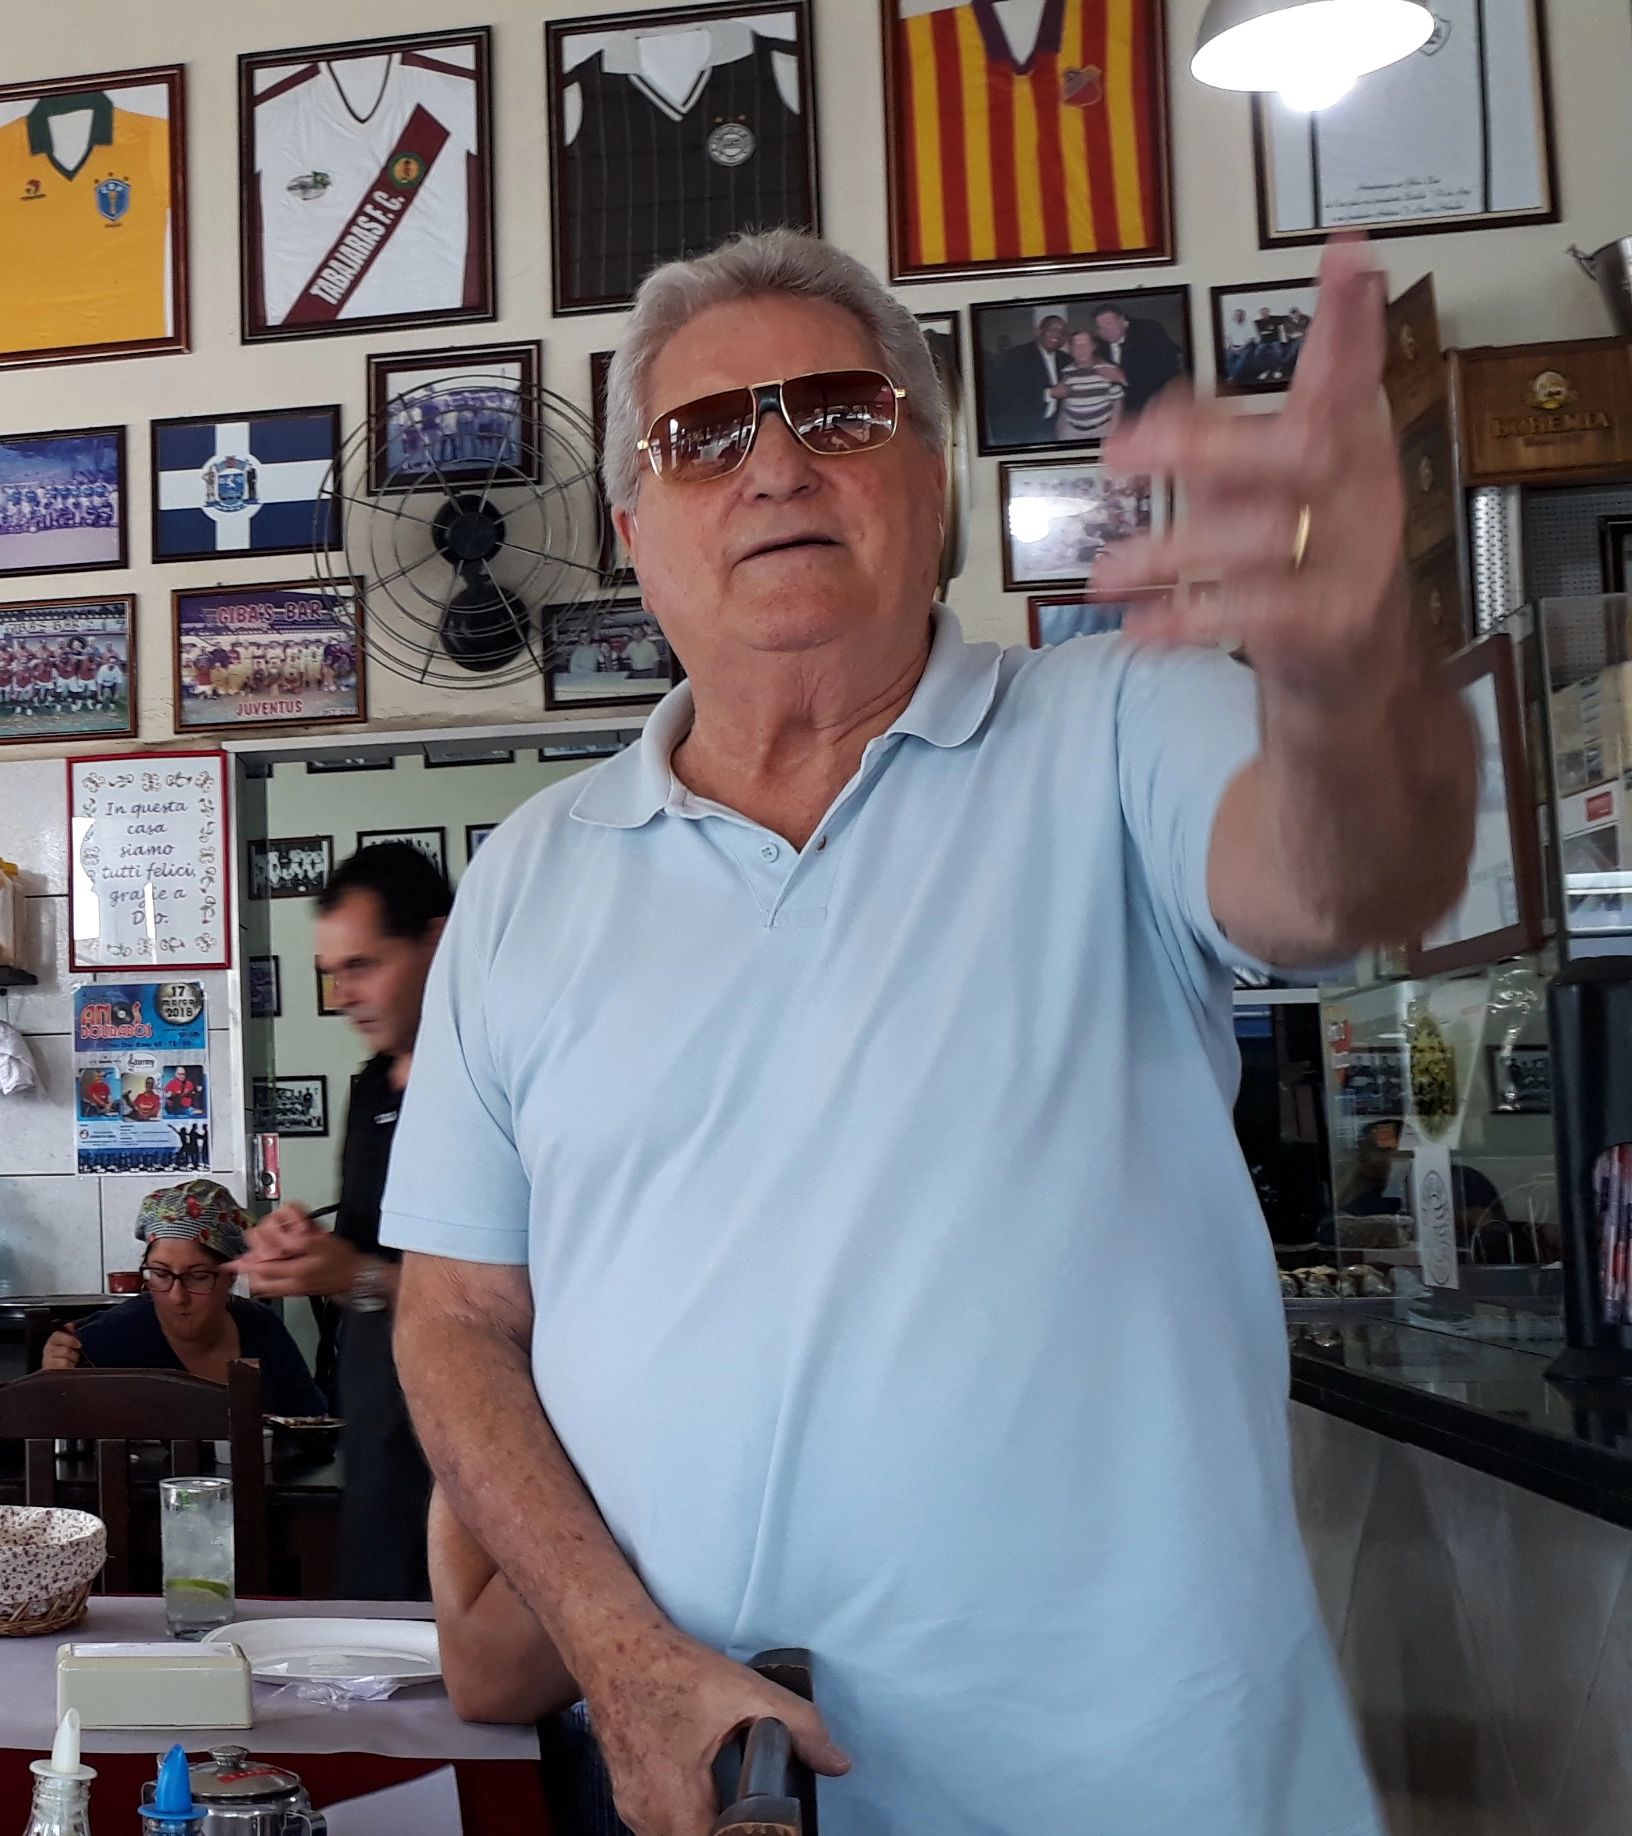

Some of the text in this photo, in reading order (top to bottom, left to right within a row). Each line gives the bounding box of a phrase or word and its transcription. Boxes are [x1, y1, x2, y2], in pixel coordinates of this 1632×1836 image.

[308, 215, 387, 305] TABAJARAS
[216, 600, 323, 625] GIBA'S BAR
[236, 700, 303, 717] JUVENTUS
[104, 801, 188, 819] In questa
[127, 823, 168, 836] casa
[119, 843, 176, 858] siamo
[102, 862, 196, 881] tutti felici,
[173, 888, 186, 900] a
[132, 910, 169, 925] Do.
[172, 985, 185, 997] 17
[166, 1007, 193, 1018] 2018
